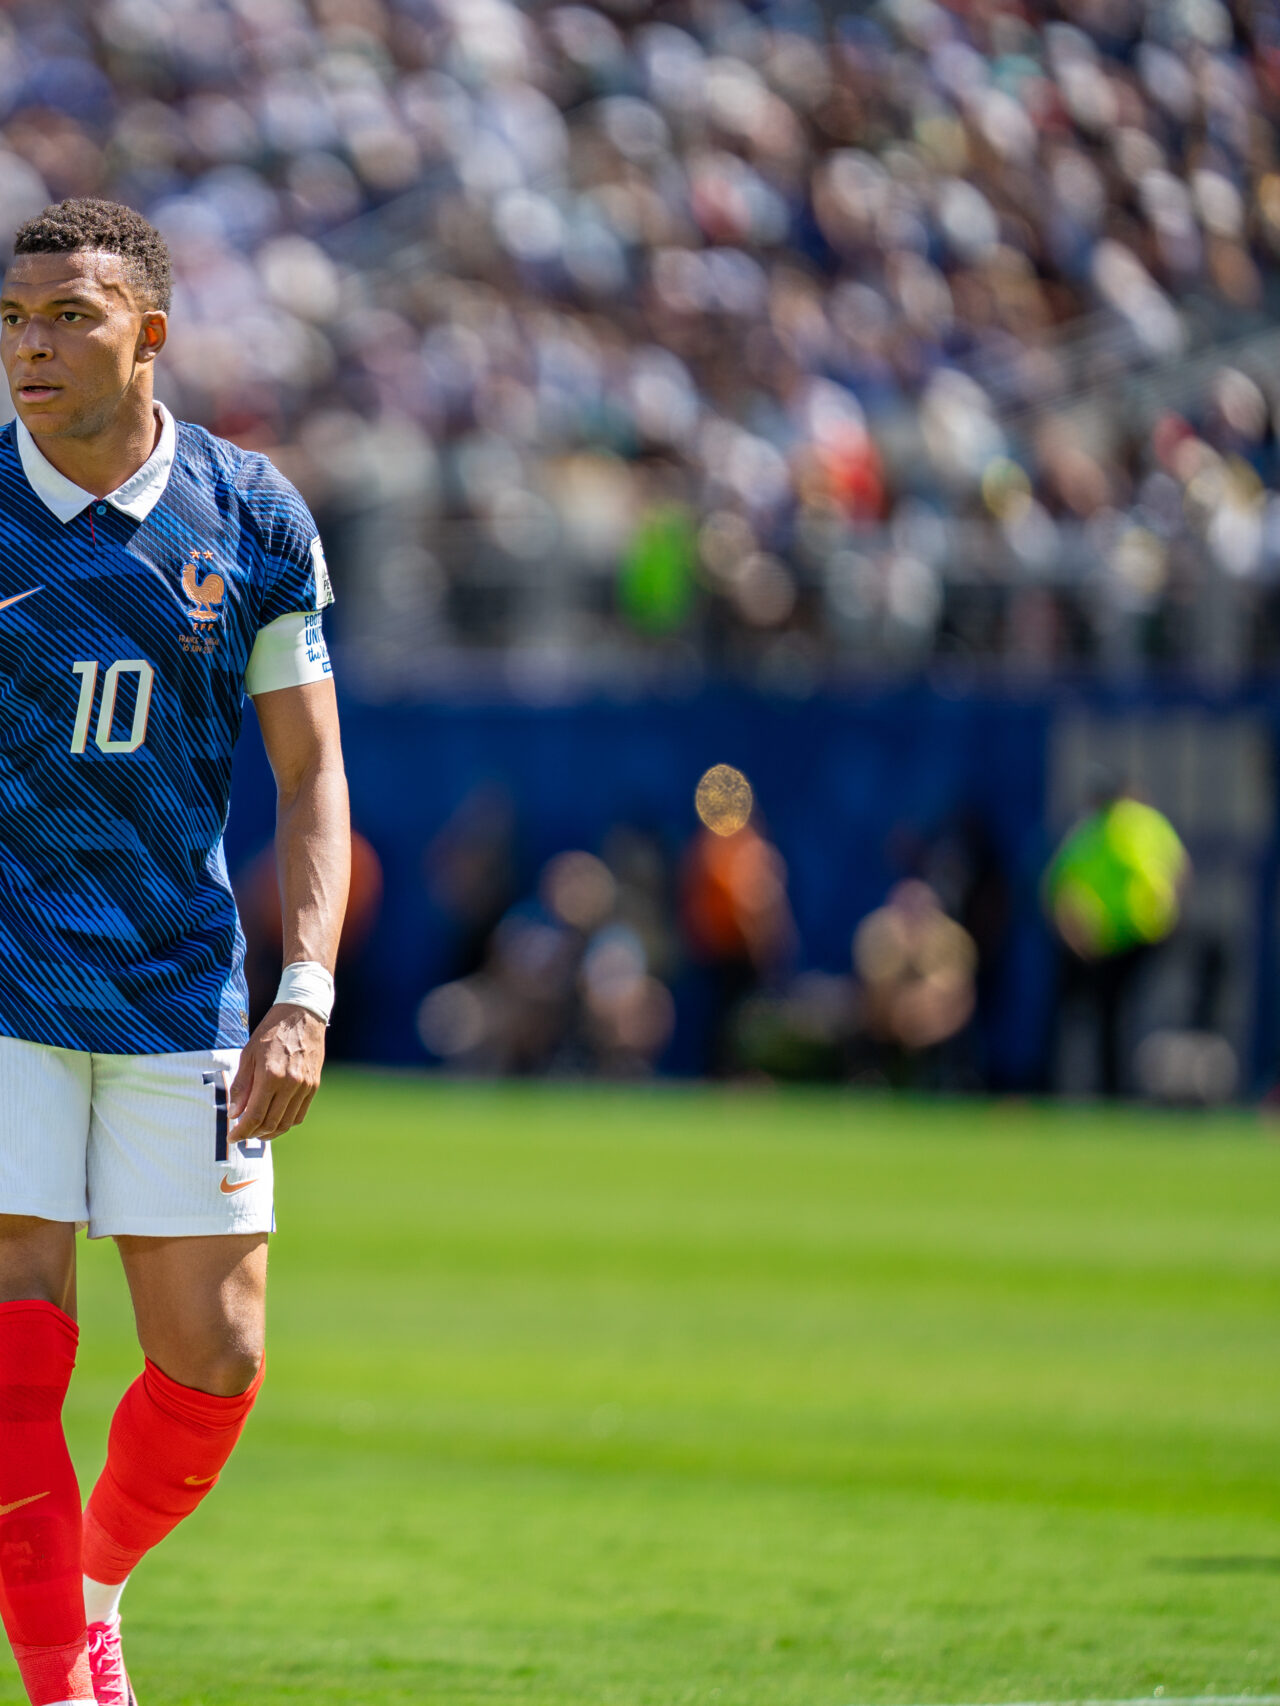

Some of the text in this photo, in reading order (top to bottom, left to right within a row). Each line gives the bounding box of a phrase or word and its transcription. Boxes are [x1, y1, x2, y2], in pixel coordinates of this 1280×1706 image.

[193, 622, 214, 632] FFF
[304, 612, 322, 628] FOOT
[305, 626, 324, 646] UNIT
[70, 659, 155, 754] 10
